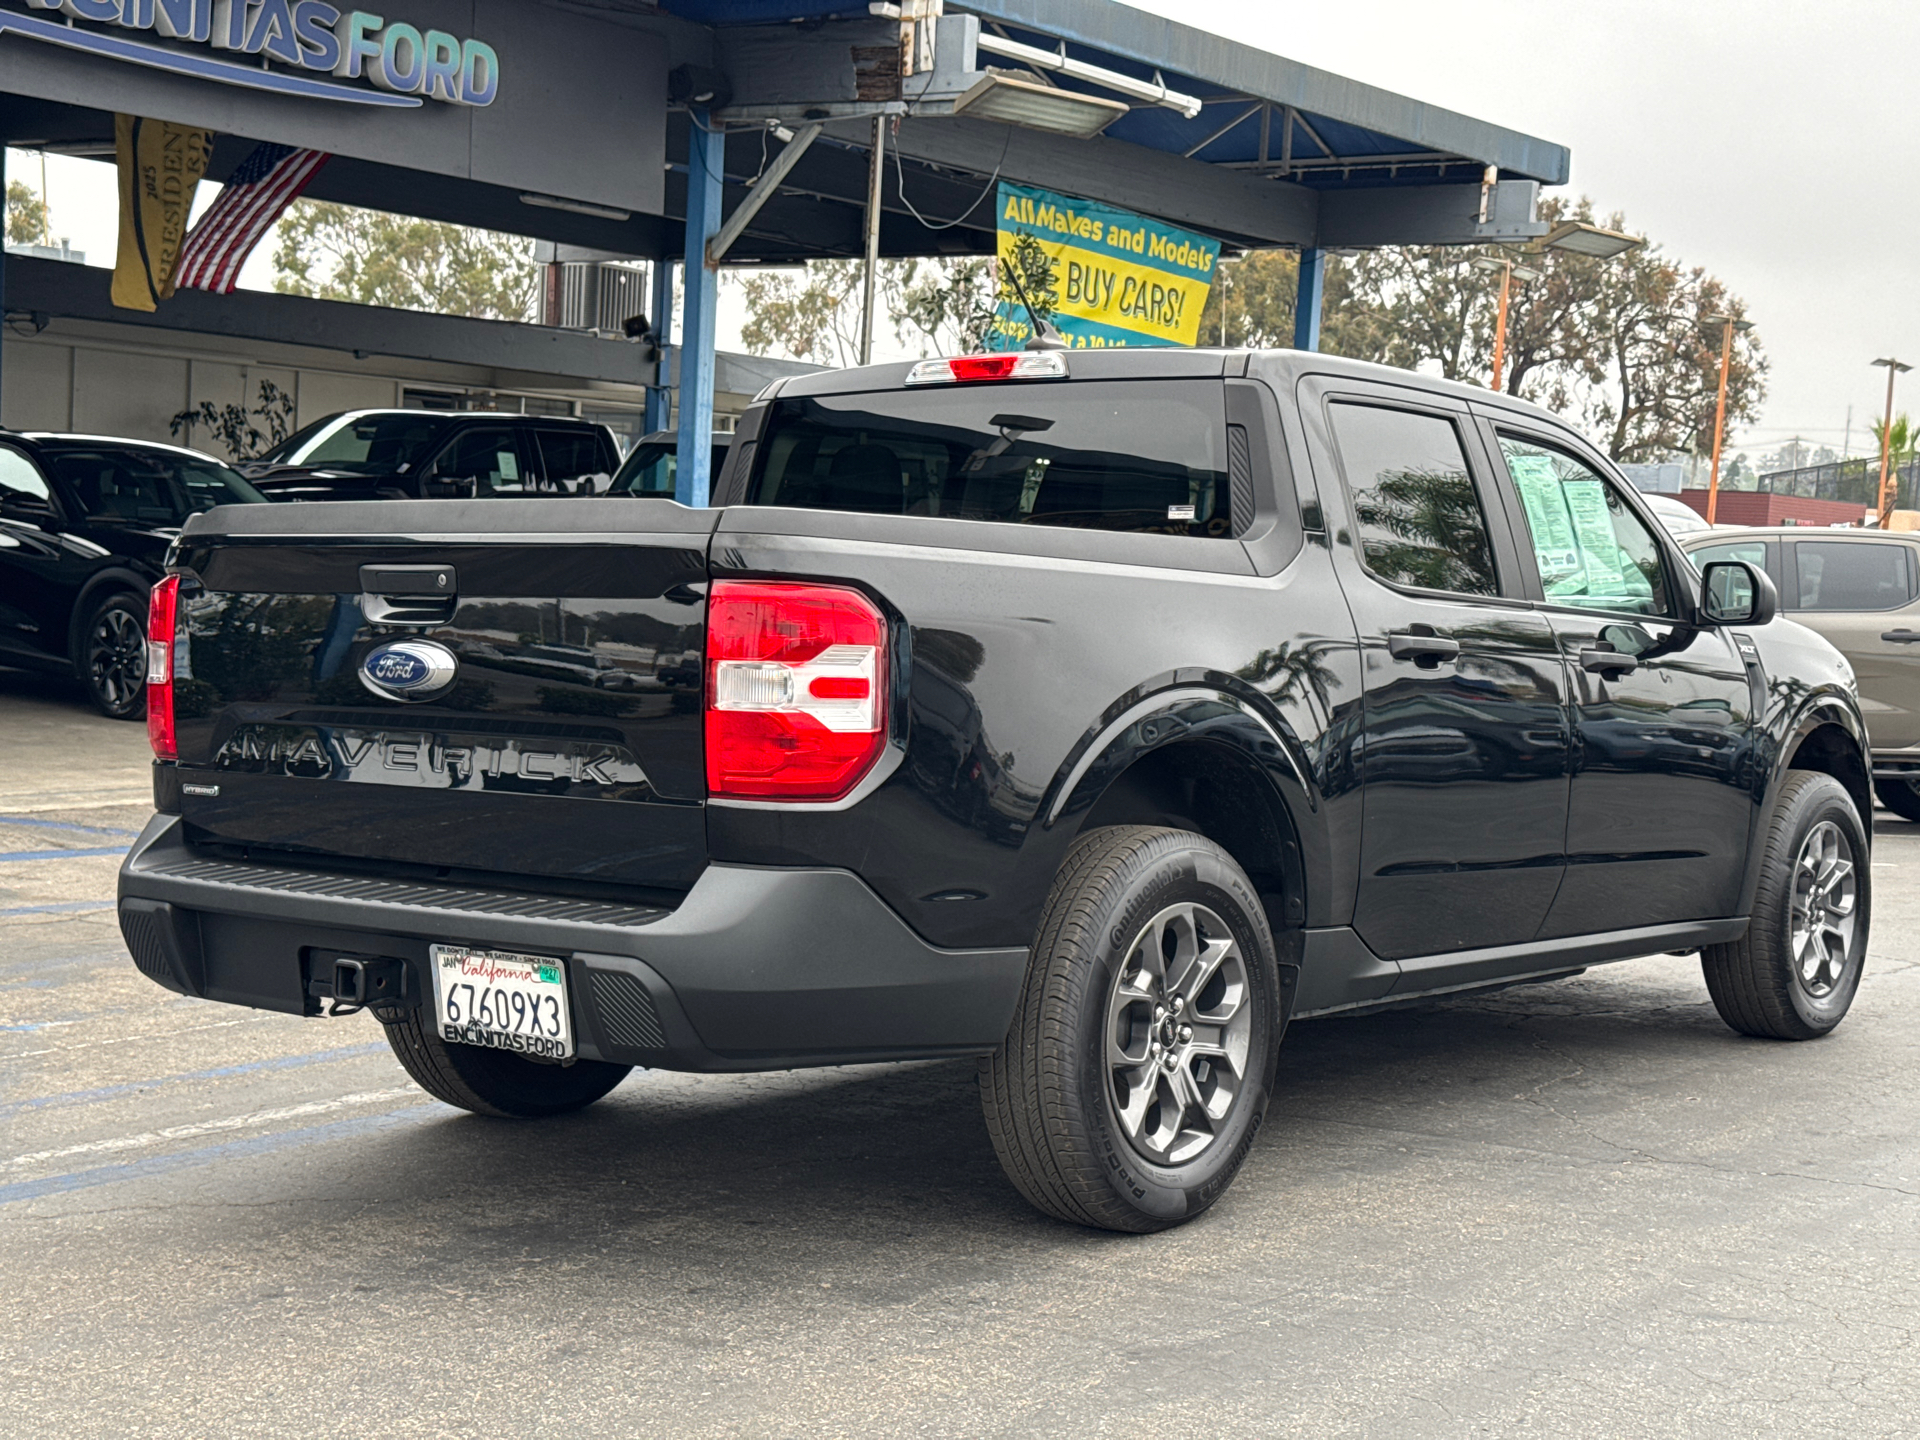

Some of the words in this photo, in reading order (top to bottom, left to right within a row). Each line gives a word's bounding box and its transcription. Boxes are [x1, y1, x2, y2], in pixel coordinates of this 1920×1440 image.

[348, 10, 500, 108] FORD
[143, 165, 158, 199] 2025
[158, 122, 183, 287] PRESIDEN
[1004, 196, 1036, 224] All
[1036, 204, 1103, 241] Makes
[1107, 225, 1146, 254] and
[1148, 232, 1214, 272] Models
[1066, 261, 1117, 311] BUY
[1119, 275, 1186, 329] CARS!
[376, 654, 415, 679] Ford
[240, 733, 614, 786] MAVERICK
[185, 786, 215, 795] HYBRID
[442, 956, 457, 969] JAN
[461, 955, 541, 985] California
[494, 952, 518, 961] SATISFY
[447, 983, 560, 1037] 67609X3
[444, 1025, 524, 1050] ENCINITAS
[526, 1034, 566, 1058] FORD
